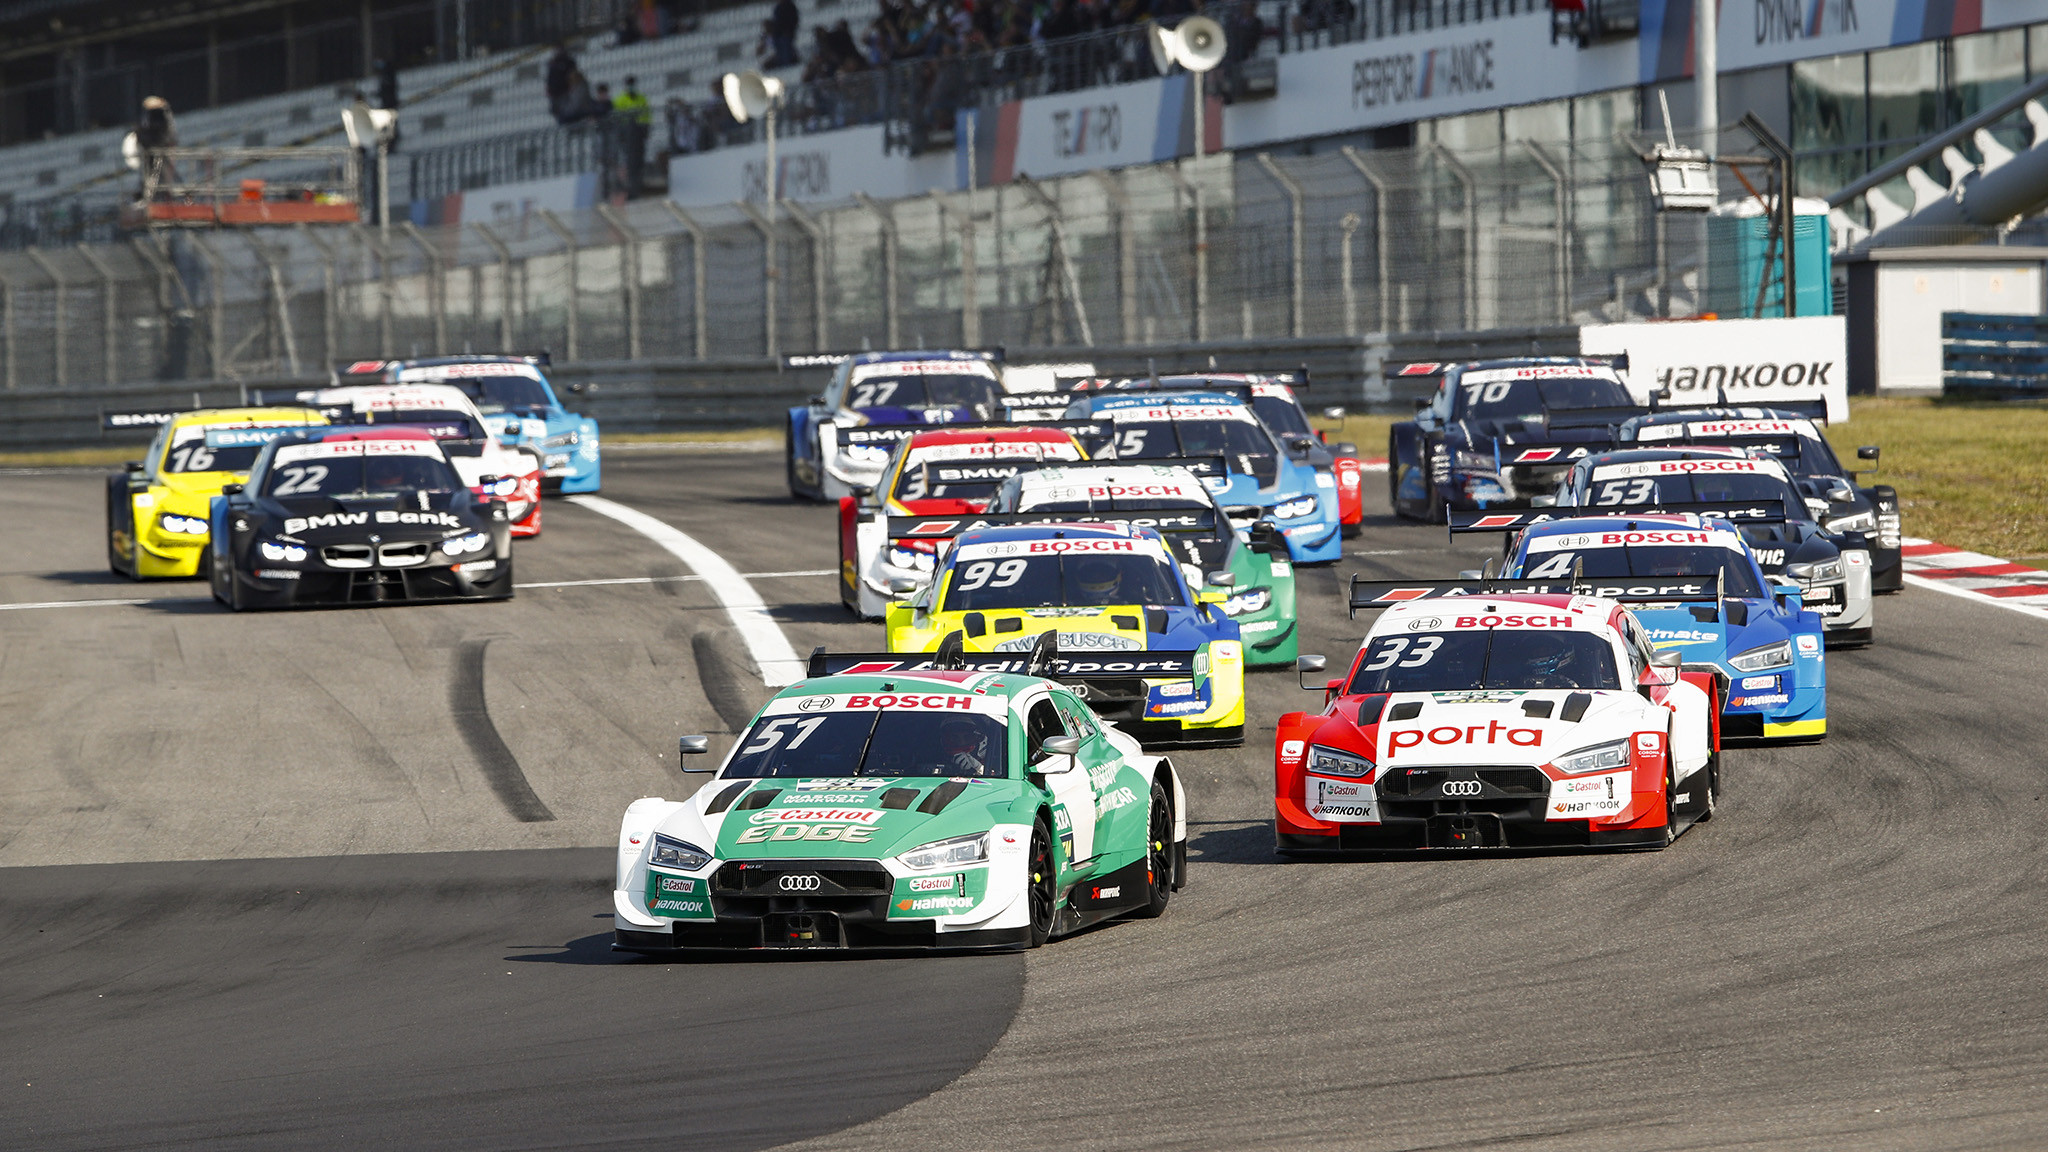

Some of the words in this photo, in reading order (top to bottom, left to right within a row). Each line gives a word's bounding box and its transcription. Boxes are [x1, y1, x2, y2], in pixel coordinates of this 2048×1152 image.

[1755, 0, 1858, 44] DYNAIK
[788, 354, 850, 366] BMW
[901, 362, 973, 374] BOSCH
[1517, 367, 1594, 377] BOSCH
[852, 381, 899, 408] 27
[1465, 381, 1512, 405] 10
[371, 399, 445, 408] BOSCH
[1001, 394, 1071, 406] BMW
[1148, 409, 1233, 418] BOSCH
[1702, 421, 1790, 433] BOSCH
[334, 443, 416, 453] BOSCH
[970, 444, 1056, 455] BOSCH
[171, 446, 215, 473] 16
[1660, 461, 1755, 473] BOSCH
[939, 467, 1019, 481] BMW
[272, 466, 329, 497] 22
[1087, 485, 1183, 498] BOSCH
[1597, 480, 1655, 505] 53
[284, 512, 368, 535] BMW
[375, 510, 460, 529] Bank
[1602, 532, 1709, 544] BOSCH
[1029, 541, 1134, 553] BOSCH
[1528, 552, 1576, 578] 4
[958, 559, 1028, 591] 99
[1572, 584, 1702, 597] Sport
[1455, 615, 1573, 629] BOSCH
[1648, 628, 1719, 641] timate
[1001, 635, 1039, 651] TWI
[1058, 633, 1129, 649] BUSCH
[1363, 636, 1445, 671] 33
[1048, 660, 1183, 673] Sport
[846, 694, 972, 710] BOSCH
[742, 716, 828, 754] 51
[1387, 720, 1543, 758] porta
[1333, 785, 1359, 796] Castrol
[1576, 780, 1602, 791] Castrol
[780, 809, 874, 822] Castrol
[1320, 804, 1371, 817] HANKOOK
[736, 824, 884, 845] EDGE
[668, 880, 693, 892] Castrol
[921, 878, 952, 890] Castrol
[654, 899, 704, 912] HANKOOK
[911, 897, 974, 911] HANKOOK
